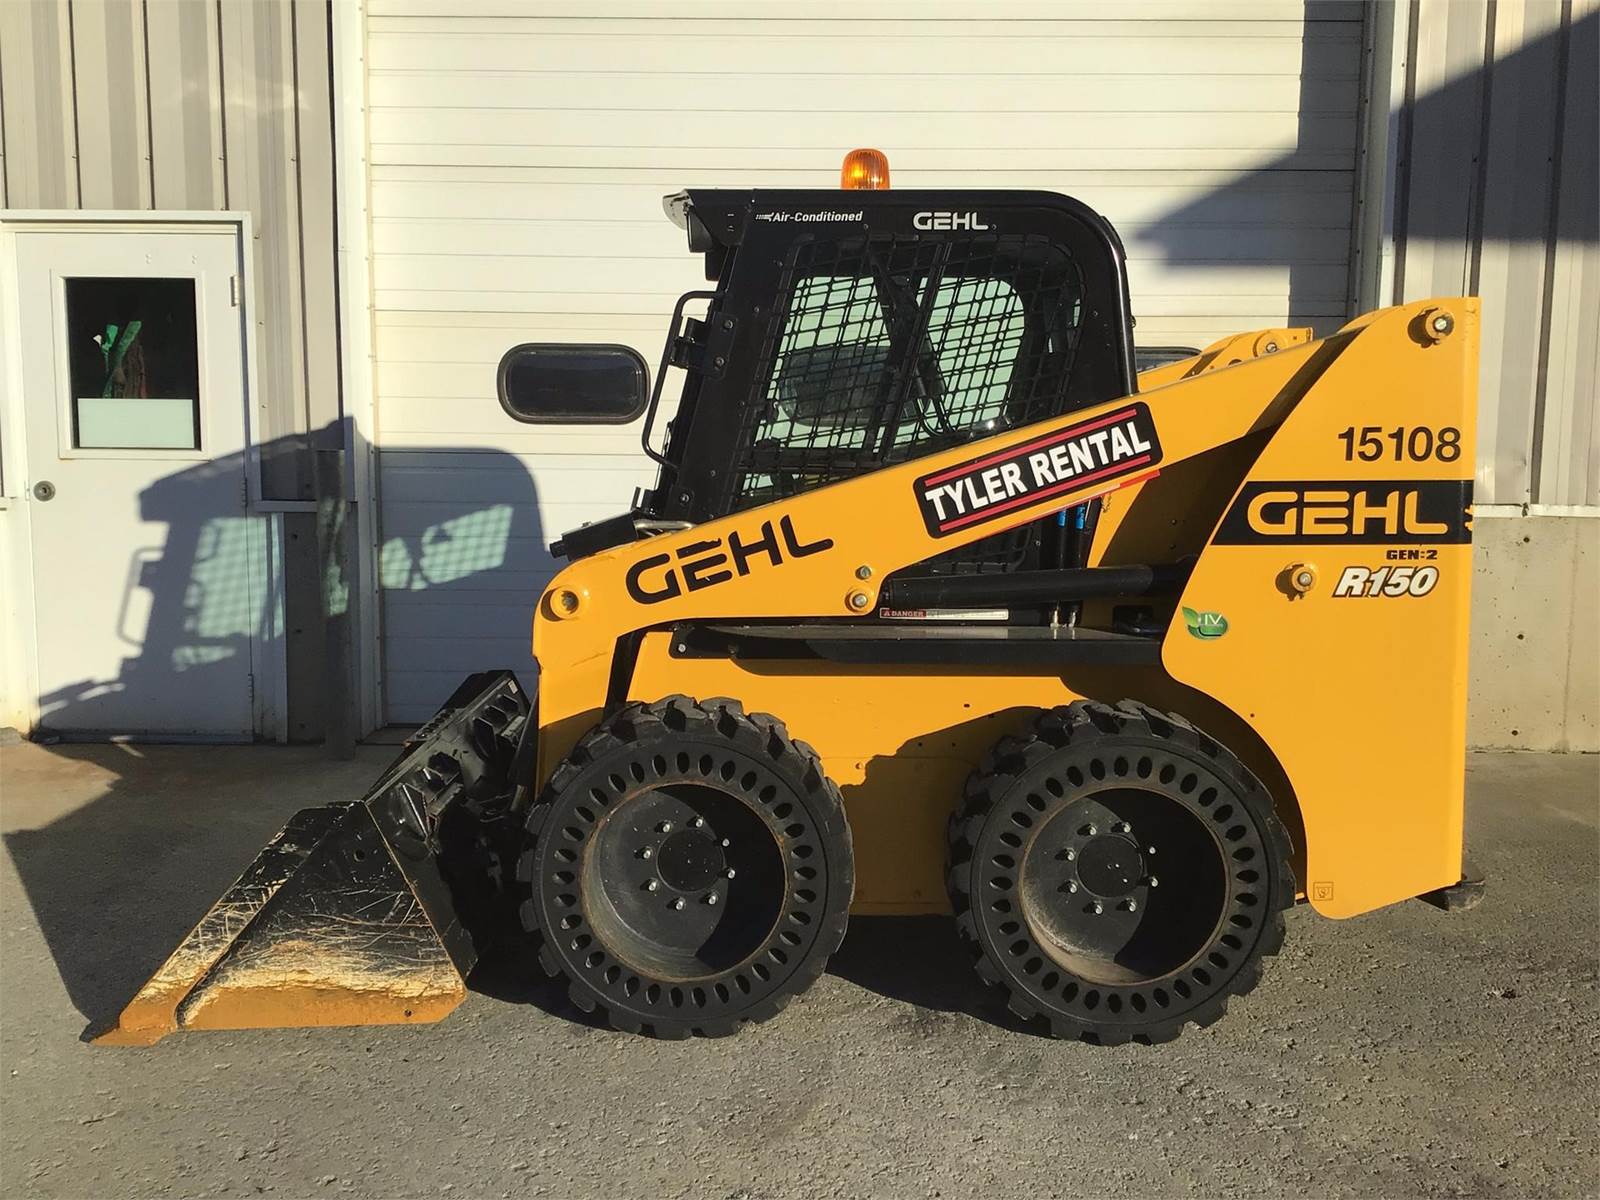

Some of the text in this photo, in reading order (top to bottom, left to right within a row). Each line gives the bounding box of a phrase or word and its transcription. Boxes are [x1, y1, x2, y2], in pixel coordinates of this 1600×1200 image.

[772, 211, 863, 223] Air-Conditioned
[913, 211, 989, 231] GEHL
[1338, 426, 1461, 462] 15108
[924, 421, 1151, 521] TYLER RENTAL
[1247, 490, 1448, 535] GEHL
[625, 514, 834, 605] GEHL
[1332, 565, 1439, 598] R150
